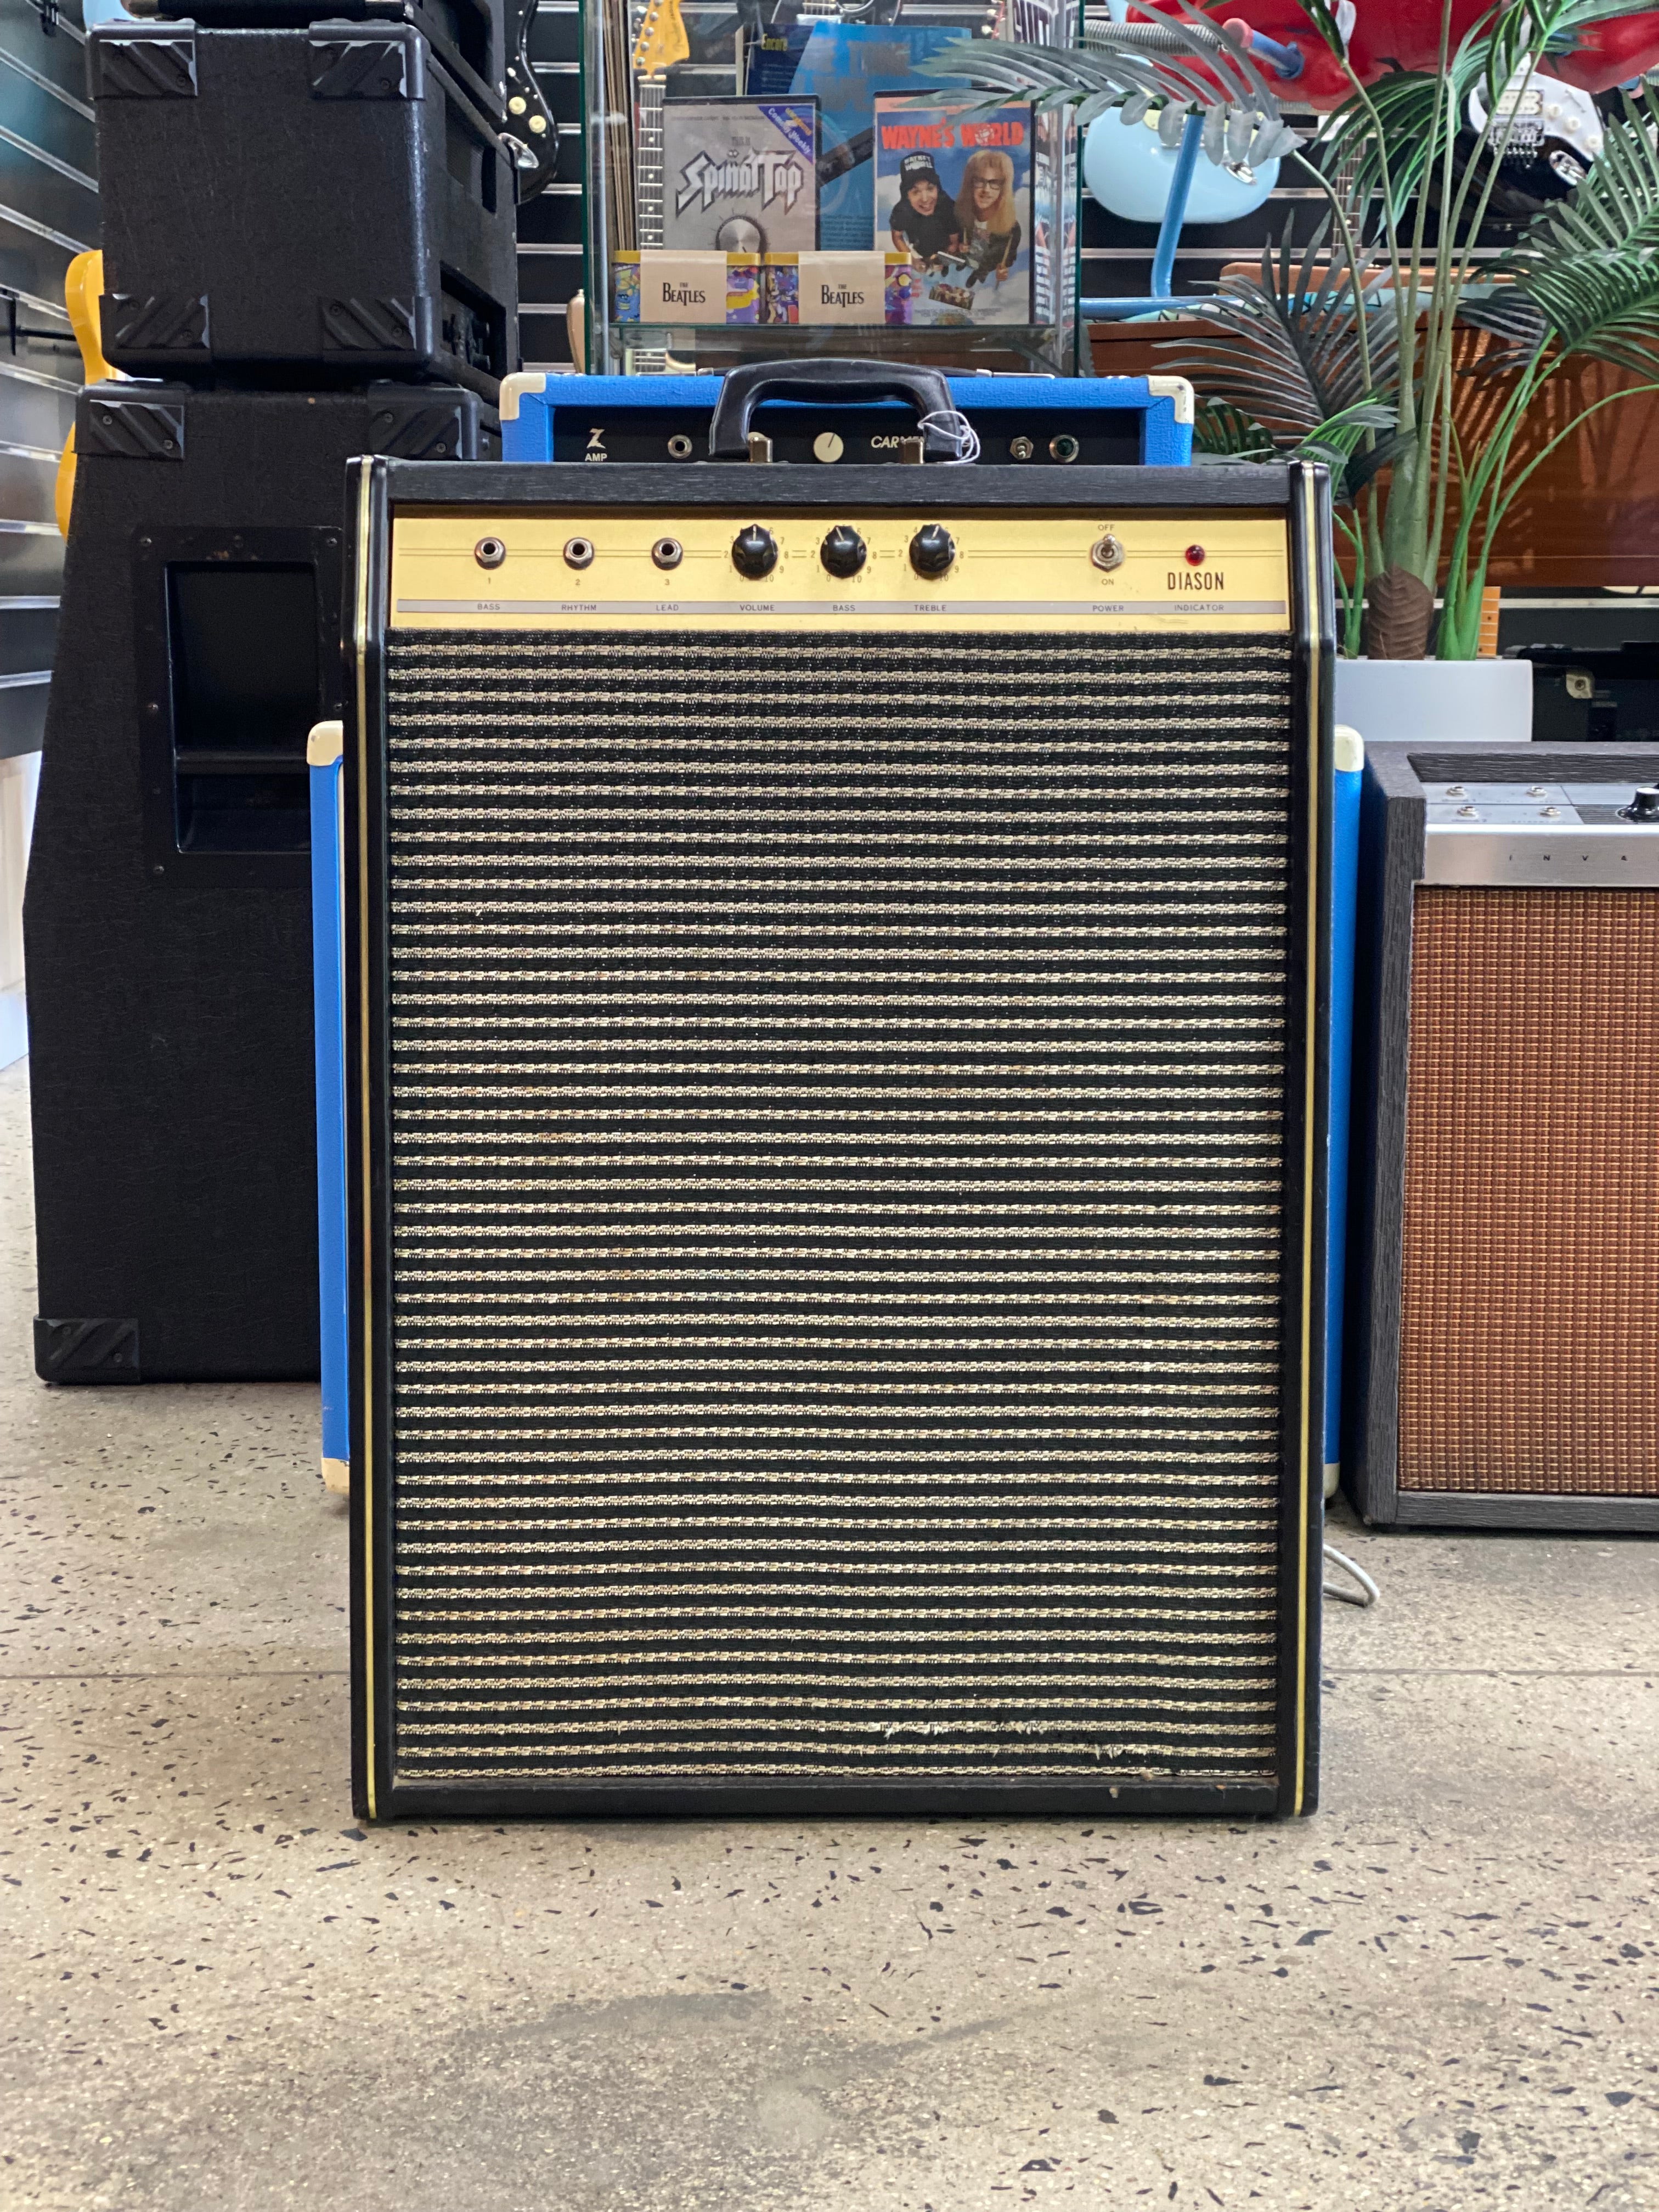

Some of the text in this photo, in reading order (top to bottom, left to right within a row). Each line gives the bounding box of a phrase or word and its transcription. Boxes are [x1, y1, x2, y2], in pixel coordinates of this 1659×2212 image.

[881, 117, 1024, 149] WAYNE'S WORLD
[585, 453, 607, 461] AMP
[898, 549, 903, 557] 2
[1167, 572, 1224, 590] DIASON
[1509, 854, 1659, 862] INVA
